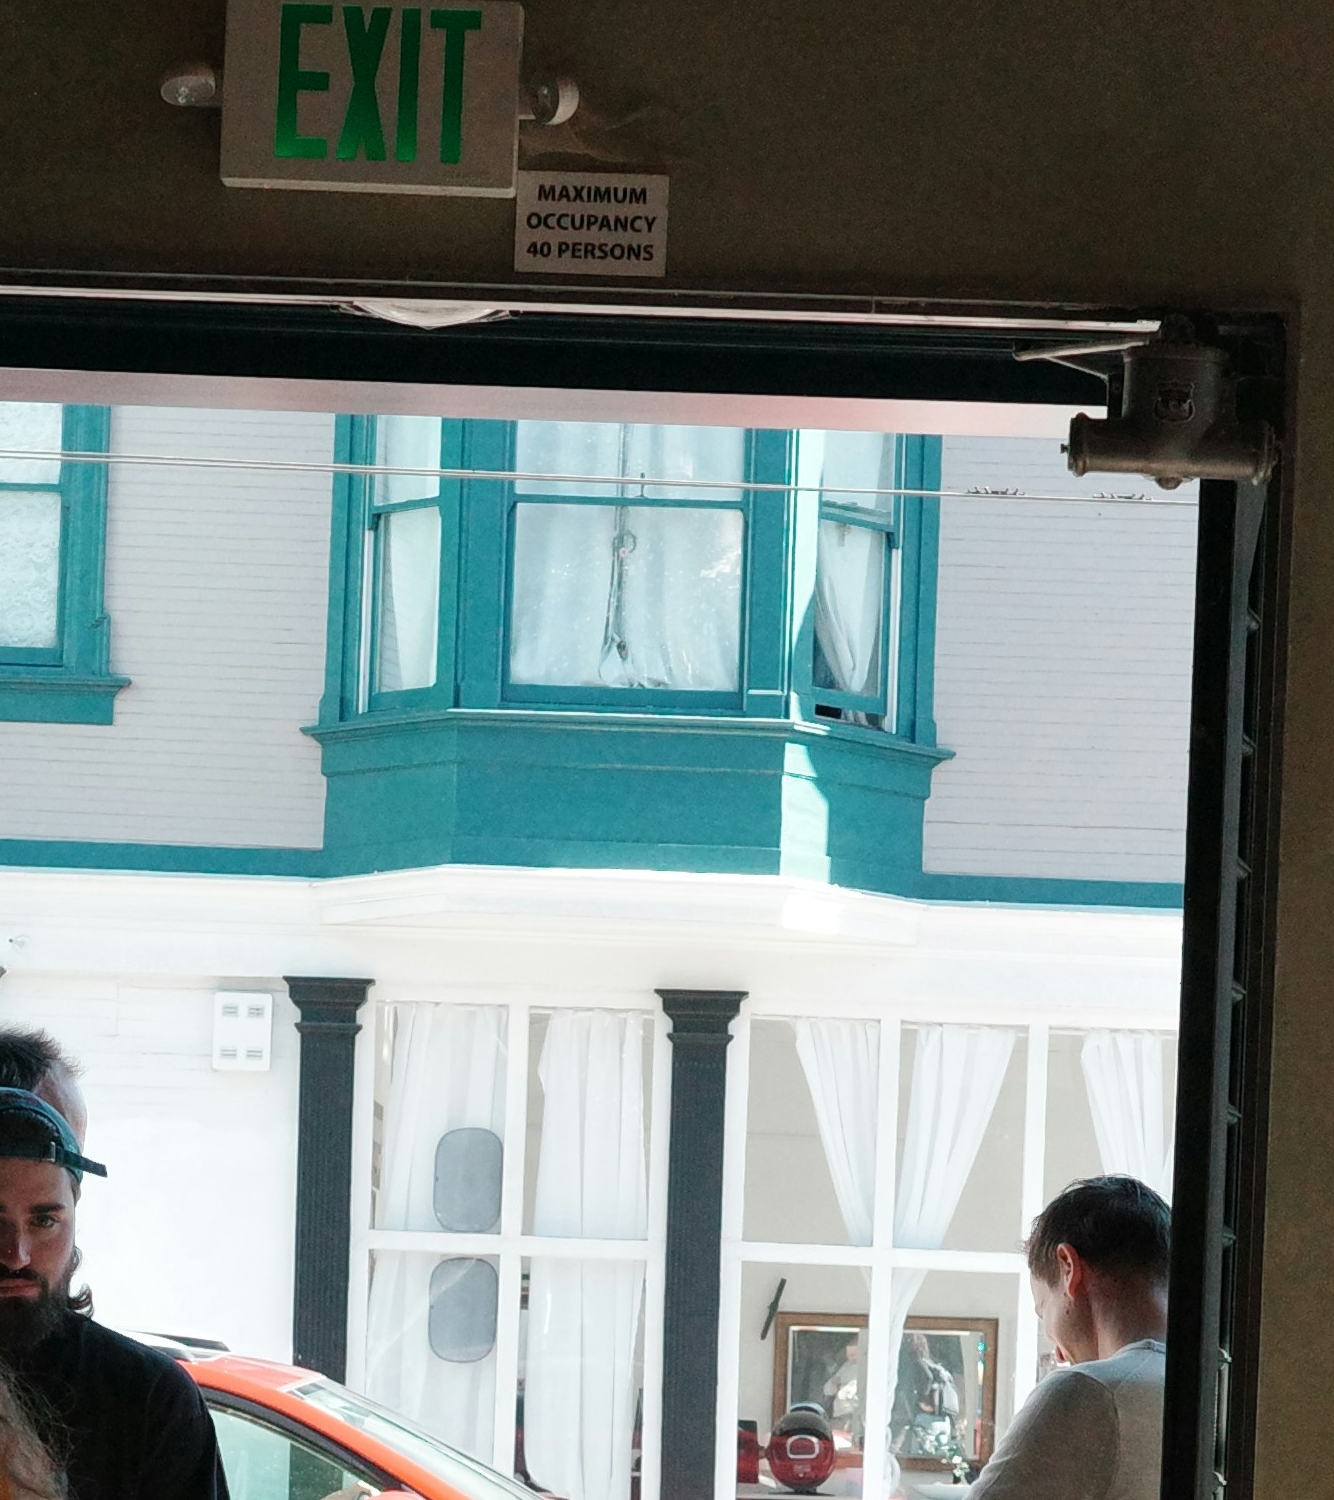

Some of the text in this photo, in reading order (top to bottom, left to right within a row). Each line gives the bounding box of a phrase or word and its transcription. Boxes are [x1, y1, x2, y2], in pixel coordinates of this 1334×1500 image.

[273, 2, 482, 165] EXIT
[537, 183, 648, 206] MAXIMUM
[526, 210, 657, 235] OCCUPANCY
[526, 240, 654, 262] 40 PERSONS
